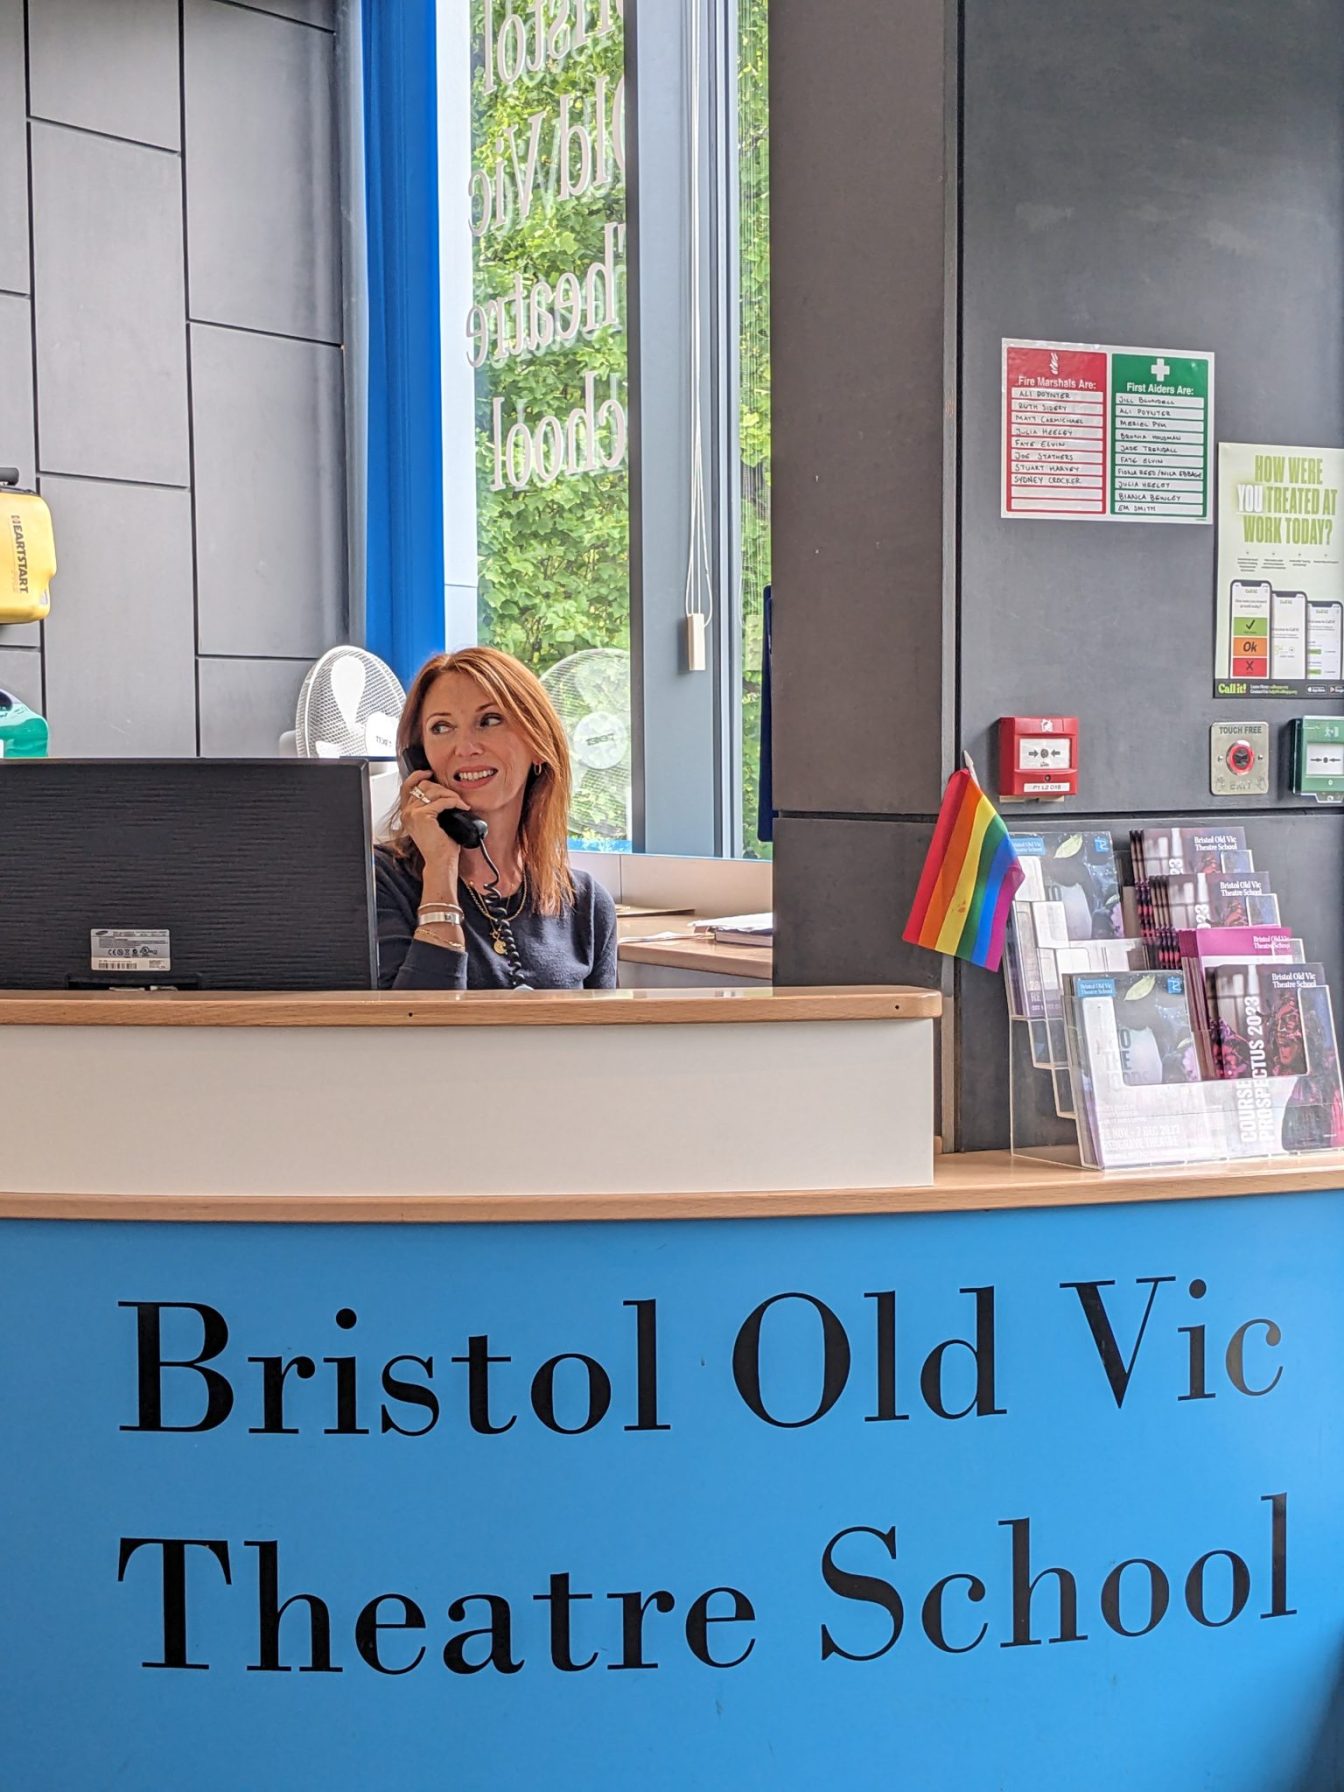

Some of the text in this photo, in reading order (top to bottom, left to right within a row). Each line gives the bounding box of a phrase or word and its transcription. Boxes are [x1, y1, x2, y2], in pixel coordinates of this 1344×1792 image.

[1018, 376, 1097, 390] Fire Marshals Are:
[1127, 382, 1194, 395] First Aiders Are:
[1014, 452, 1030, 460] JOE
[1014, 464, 1045, 472] STUART
[1254, 455, 1323, 485] HOW WERE
[1237, 484, 1338, 516] YOU TREATED AT
[1243, 515, 1333, 545] WORK TODAY?
[1243, 641, 1257, 653] Ok
[1219, 726, 1262, 734] TOUCH FREE
[1194, 836, 1214, 844] Bristol
[1305, 972, 1316, 980] Vic
[1245, 996, 1274, 1144] PROSPECTUS 2023
[1237, 1080, 1257, 1143] COURSE
[117, 1276, 1284, 1437] Bristol Old Vic
[117, 1492, 1298, 1675] Theatre School
